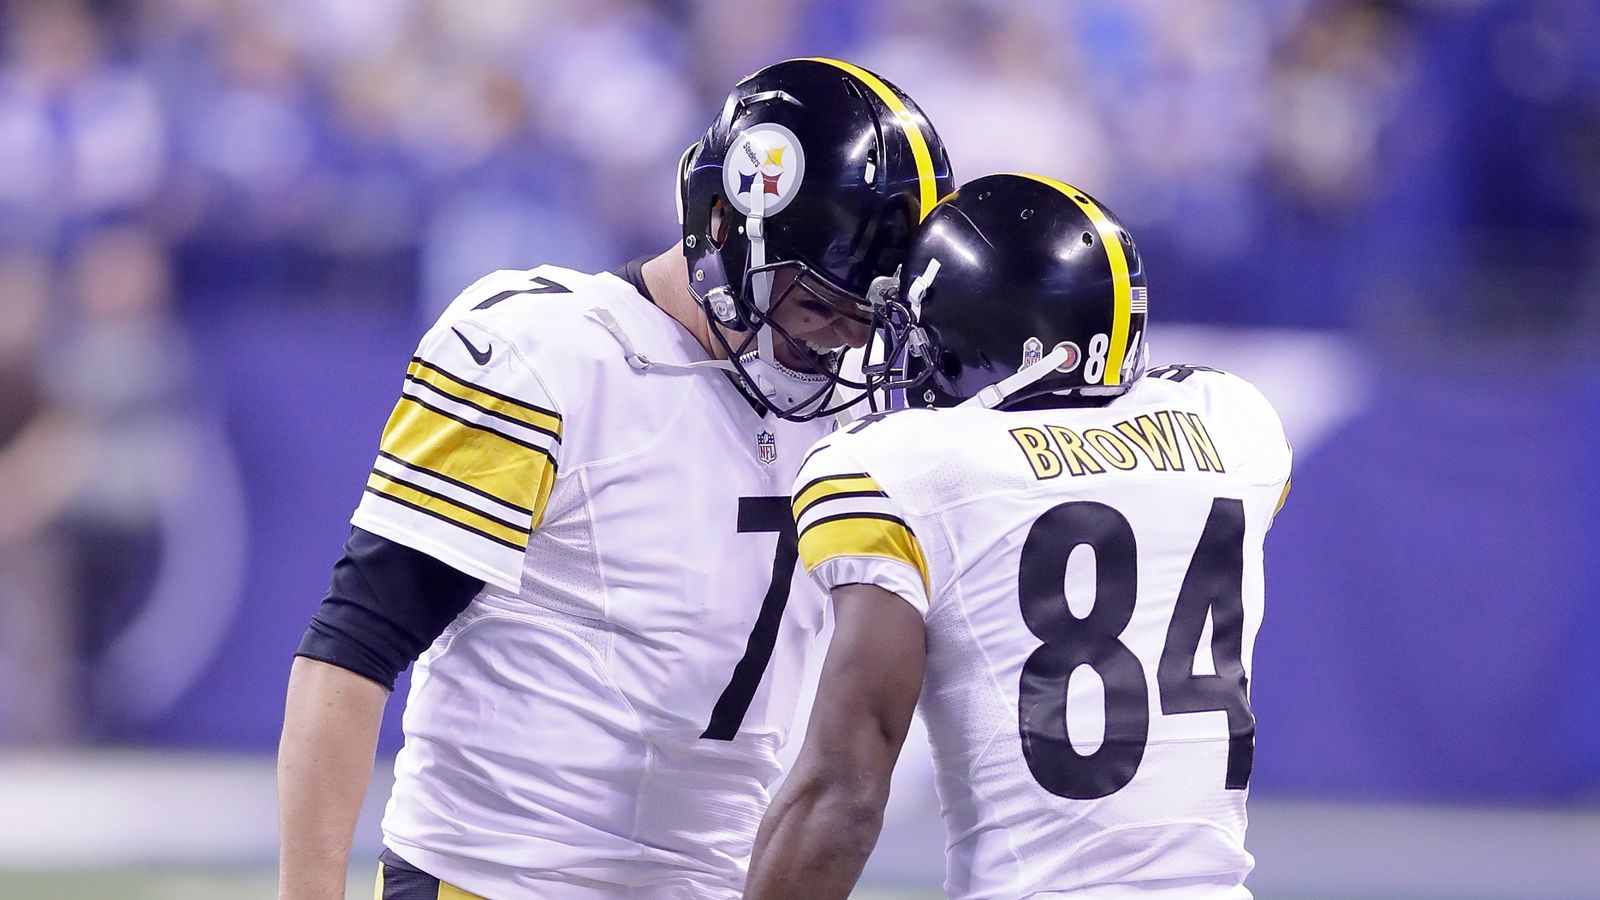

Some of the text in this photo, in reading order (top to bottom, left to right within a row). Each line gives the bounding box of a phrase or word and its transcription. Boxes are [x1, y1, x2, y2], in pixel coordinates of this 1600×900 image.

[743, 141, 760, 168] Steelers
[1083, 330, 1141, 384] 84
[760, 445, 775, 460] NFL
[1008, 410, 1226, 480] BROWN
[699, 495, 800, 742] 7
[1018, 496, 1256, 800] 84
